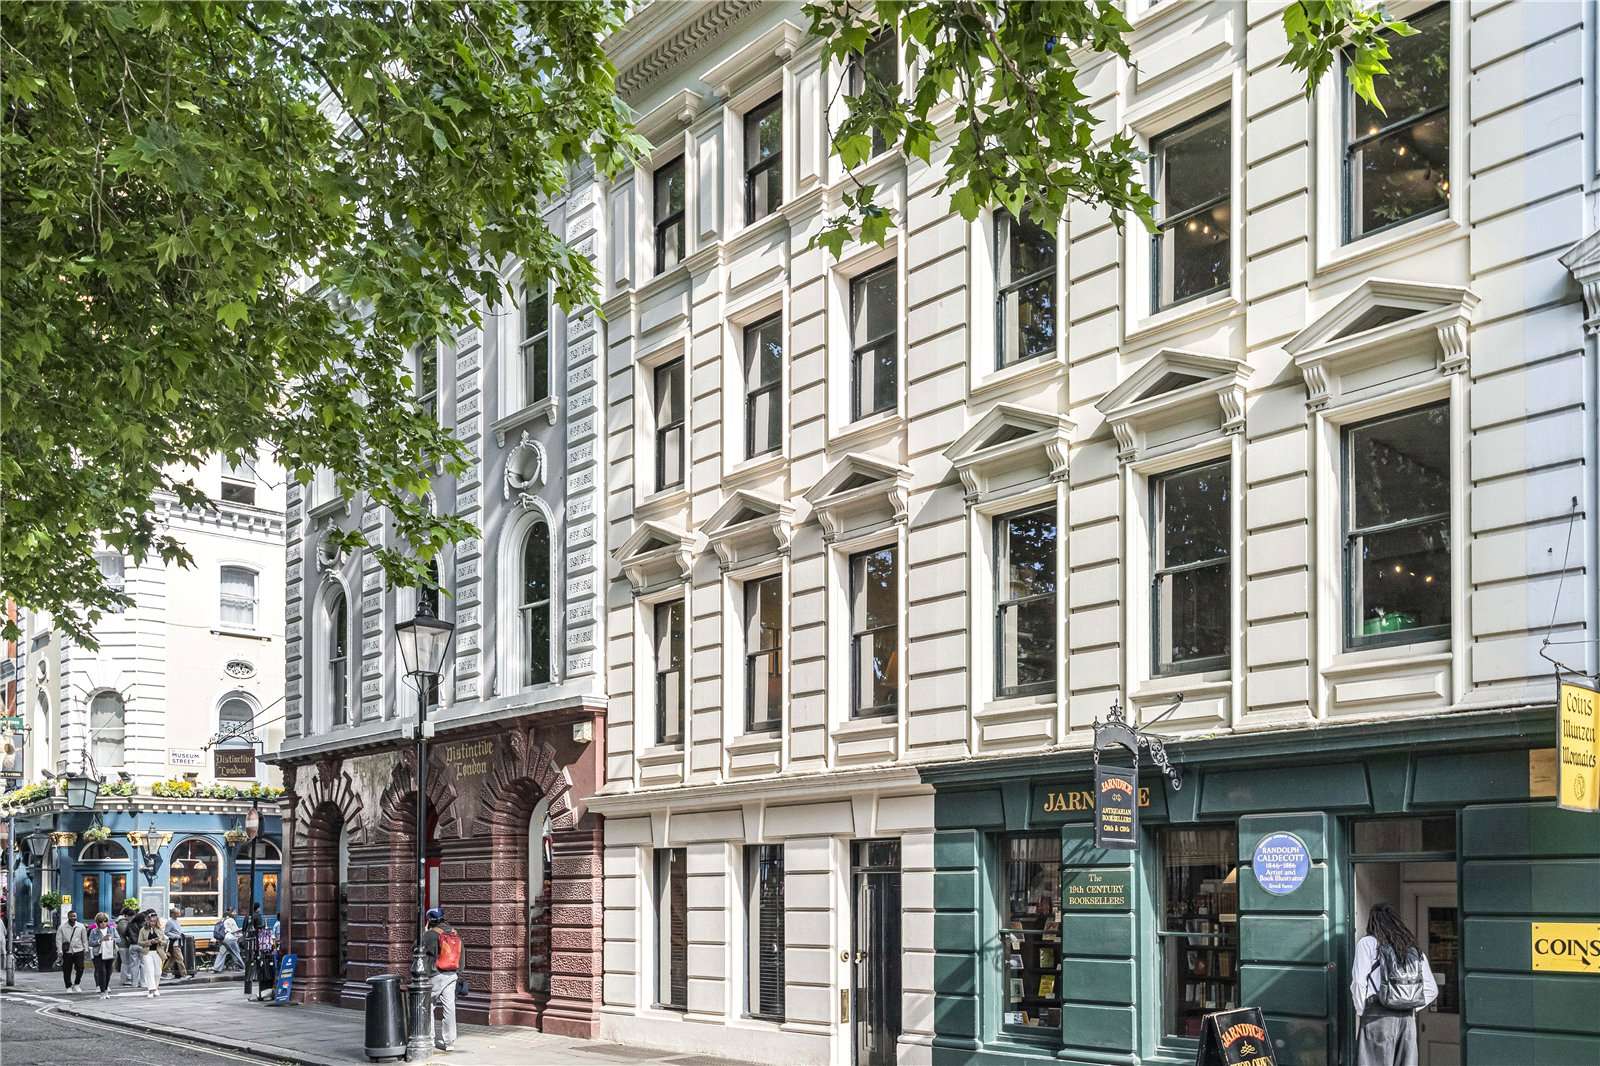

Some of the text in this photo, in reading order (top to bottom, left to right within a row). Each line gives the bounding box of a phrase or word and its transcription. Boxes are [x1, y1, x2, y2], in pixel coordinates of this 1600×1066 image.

[215, 753, 253, 767] Distinctive
[446, 740, 494, 764] Distinctive
[1562, 745, 1597, 768] Monnaies
[218, 764, 247, 776] London
[454, 758, 487, 781] London
[1043, 787, 1150, 812] JARNE
[1257, 854, 1304, 862] CALDECOTT
[1088, 873, 1102, 882] The
[1069, 885, 1124, 894] 19th CENTURY
[1069, 896, 1125, 905] BOOKSELLERS
[1534, 938, 1600, 957] COINS
[1221, 1023, 1265, 1048] JARNDYCE
